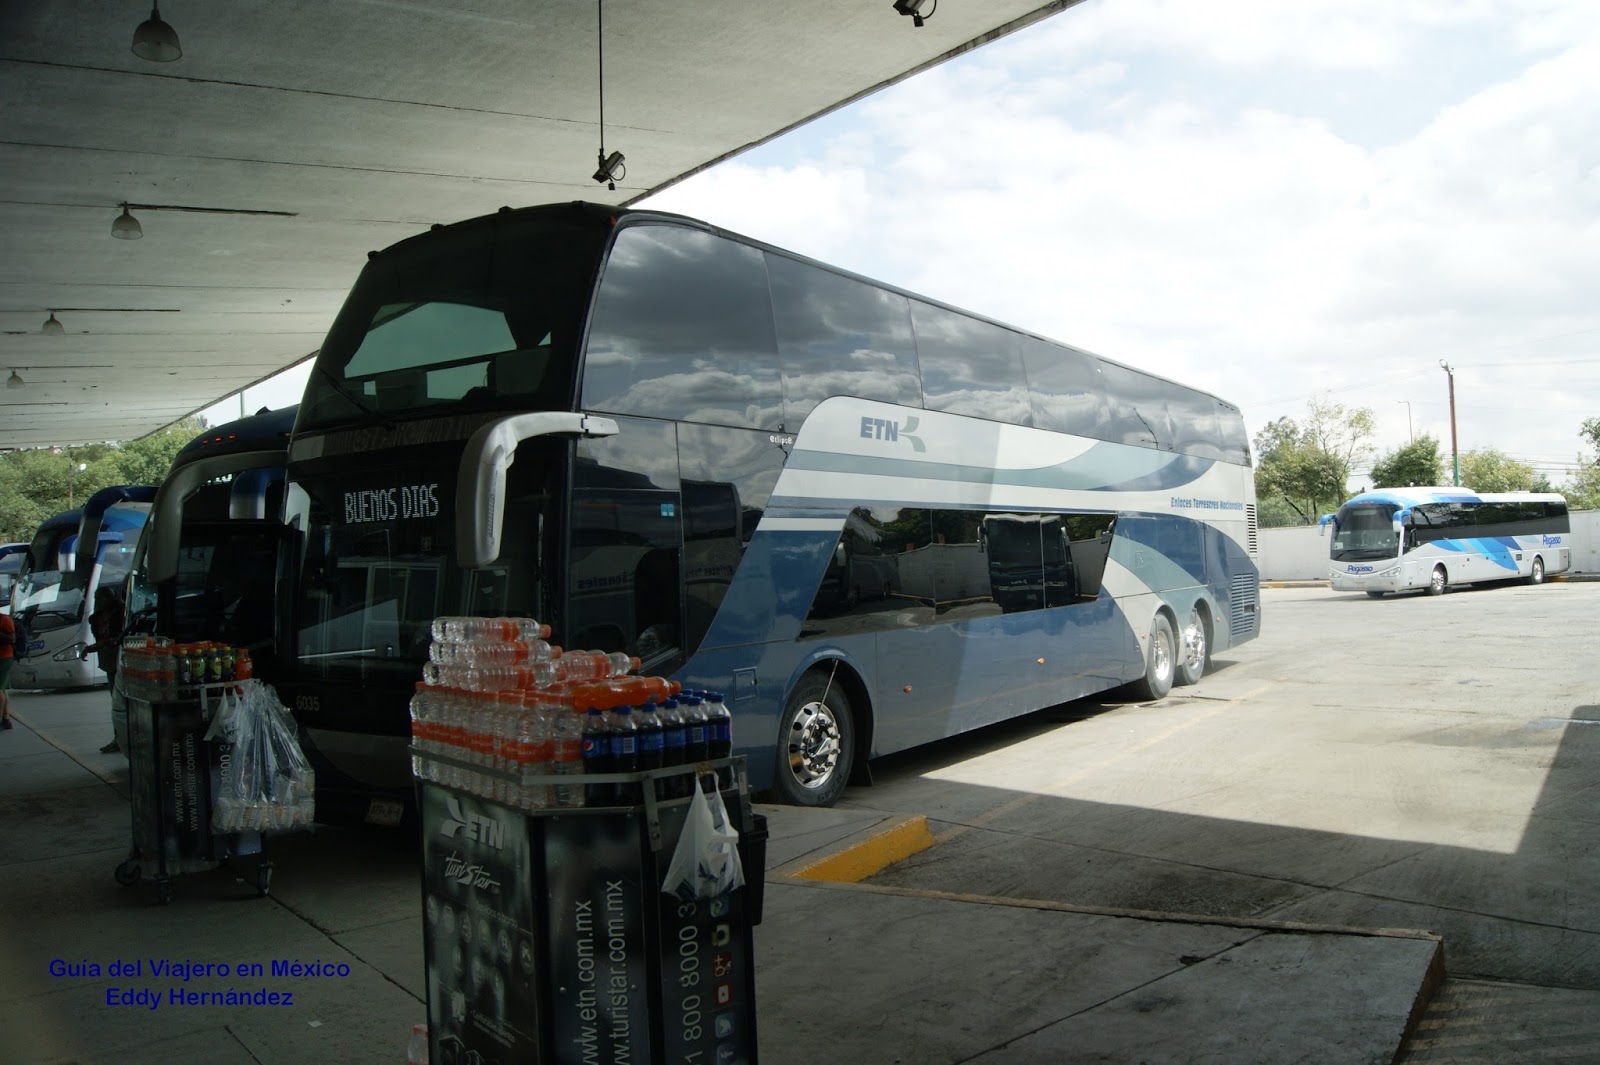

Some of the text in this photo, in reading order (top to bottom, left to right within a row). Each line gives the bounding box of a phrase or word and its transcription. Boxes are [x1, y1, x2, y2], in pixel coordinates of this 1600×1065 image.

[769, 435, 793, 445] eclipse
[860, 416, 898, 442] ETN
[344, 483, 439, 524] BUENOS DIAS
[1170, 497, 1243, 511] Enlaces Terrestres Nacionales
[1347, 564, 1373, 574] Pegasso
[296, 693, 321, 712] 6035
[172, 741, 185, 824] www.etn.com.mx
[184, 732, 198, 832] www.turistar.com.mx
[466, 812, 505, 850] ETN
[679, 925, 700, 988] 8000
[682, 995, 702, 1041] 800
